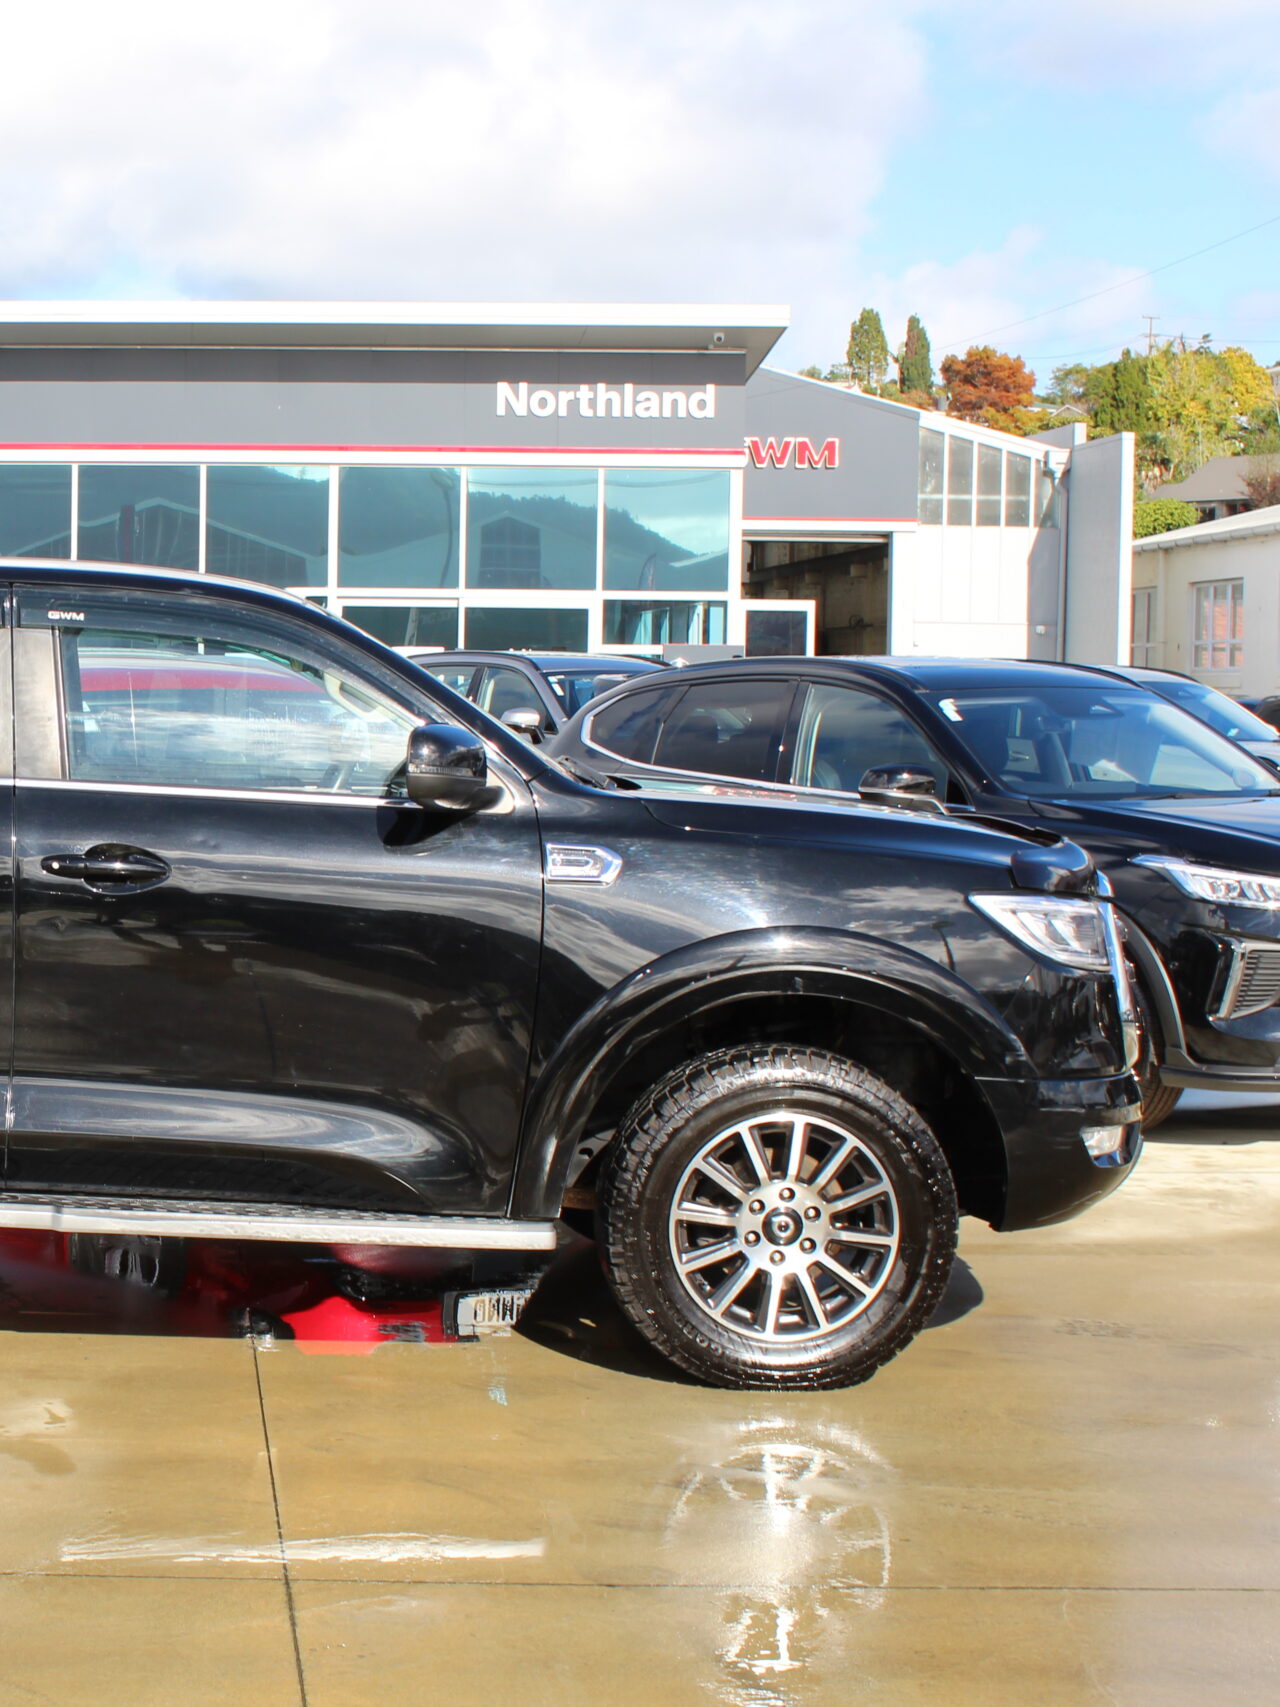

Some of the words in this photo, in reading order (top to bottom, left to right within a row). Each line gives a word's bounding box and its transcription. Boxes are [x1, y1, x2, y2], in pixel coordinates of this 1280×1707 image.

[496, 381, 717, 418] Northland
[744, 437, 840, 469] WM
[47, 610, 85, 621] GWM
